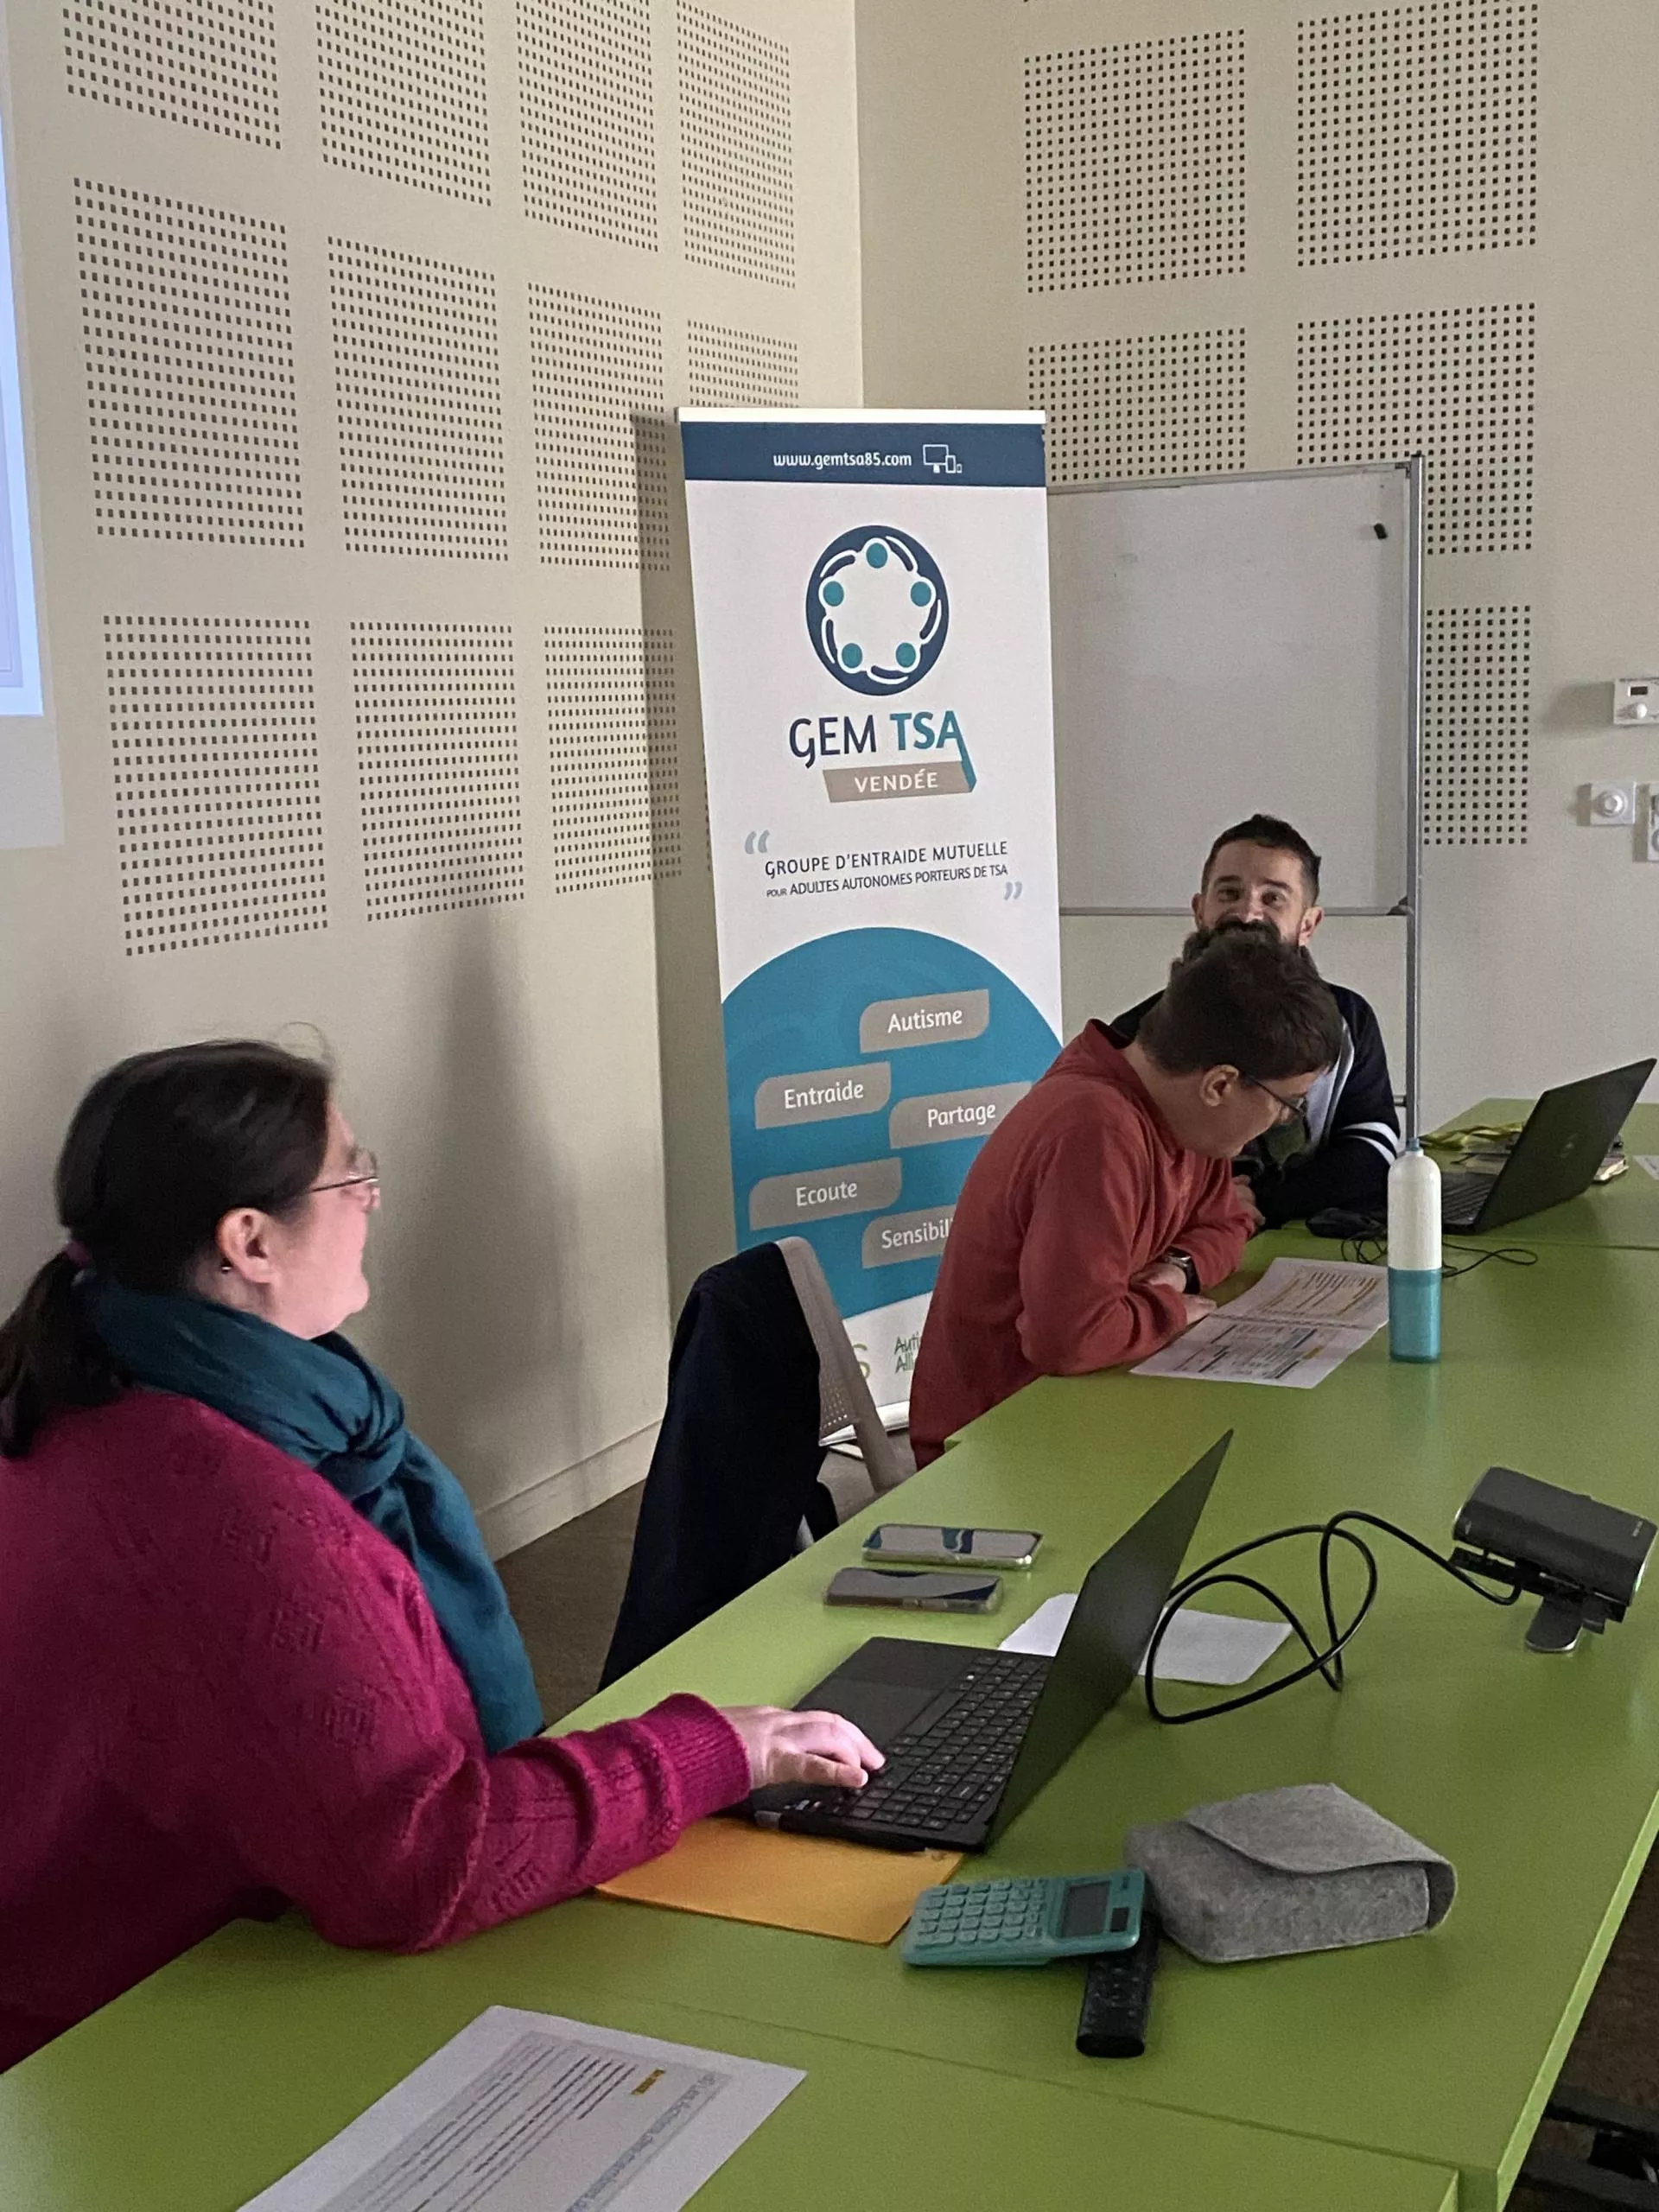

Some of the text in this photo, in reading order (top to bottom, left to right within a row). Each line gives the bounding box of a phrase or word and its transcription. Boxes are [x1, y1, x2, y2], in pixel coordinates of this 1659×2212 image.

[773, 452, 912, 470] www.gemtsa85.com
[789, 715, 877, 769] GEM
[854, 768, 938, 793] VENDÉE
[765, 841, 1008, 879] GROUPE D'ENTRAIDE MUTUELLE
[766, 864, 1008, 898] POUR ADULTES AUTONOMES PORTEURS DE TSA
[887, 1007, 963, 1033] Autisme
[784, 1080, 864, 1109] Entraide
[927, 1102, 996, 1128] Partage
[796, 1181, 858, 1207] Ecoute
[881, 1217, 953, 1249] Sensibil
